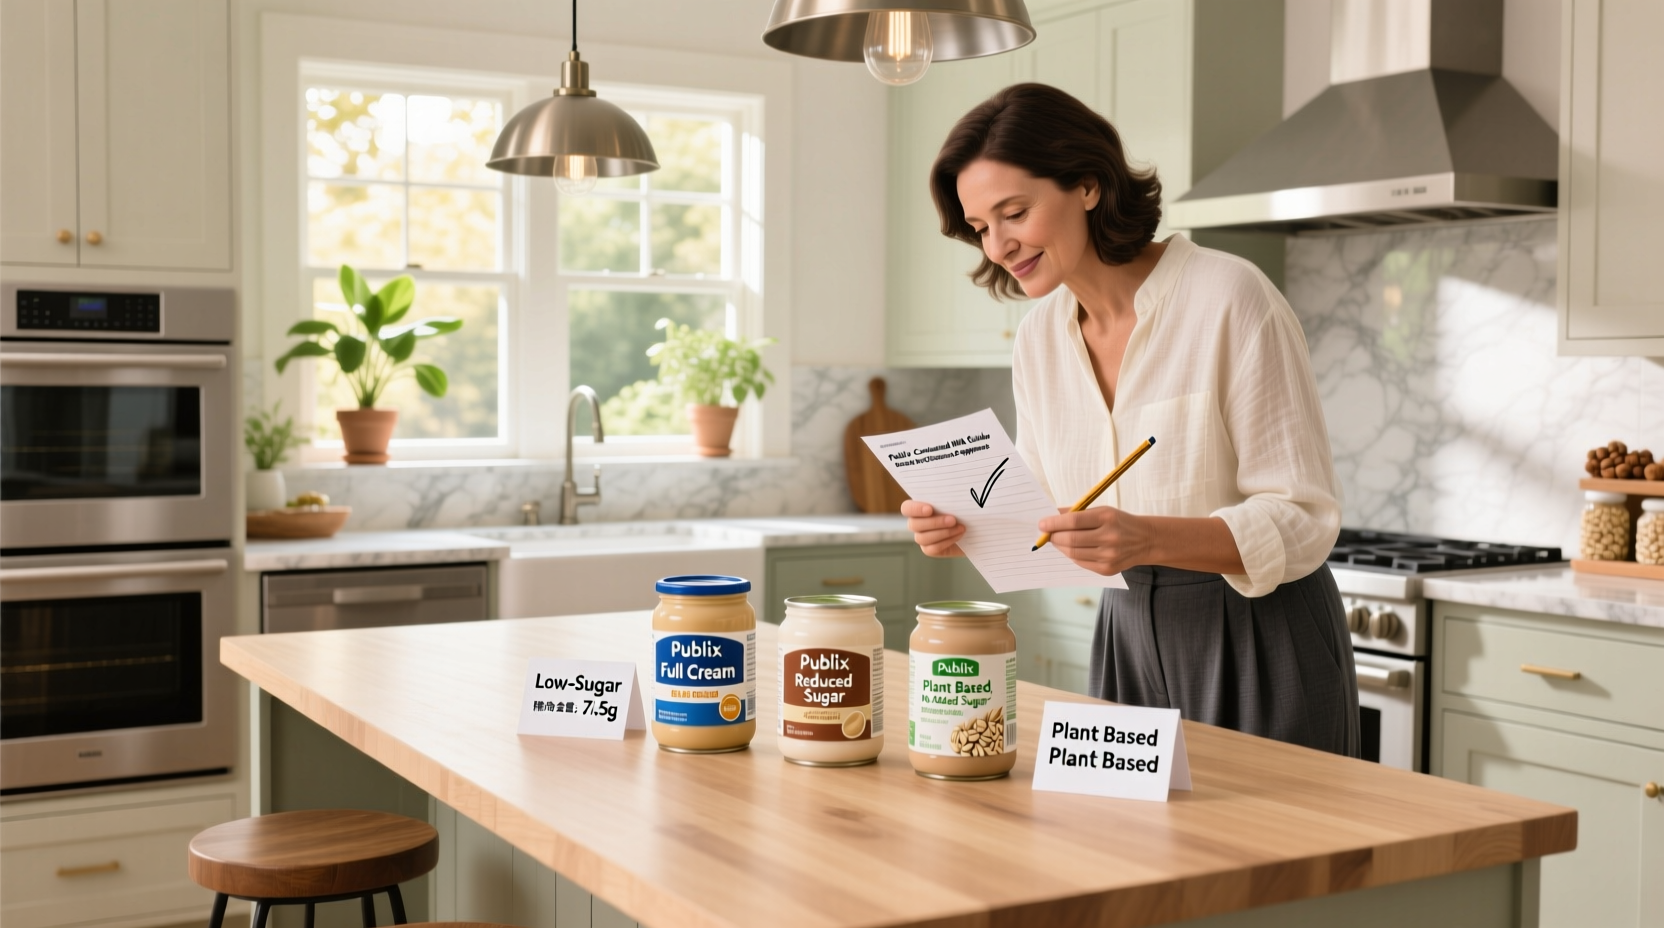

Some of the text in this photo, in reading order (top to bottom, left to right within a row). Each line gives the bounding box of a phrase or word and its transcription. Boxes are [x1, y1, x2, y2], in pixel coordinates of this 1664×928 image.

[671, 640, 722, 657] Publix
[661, 662, 736, 680] Full Cream
[800, 653, 850, 671] Publix
[535, 673, 623, 697] Low-Sugar
[795, 672, 853, 688] Reduced
[923, 679, 952, 694] Plant
[803, 688, 846, 707] Sugar
[1052, 721, 1159, 747] Plant Based
[1049, 747, 1160, 774] Plant Based
